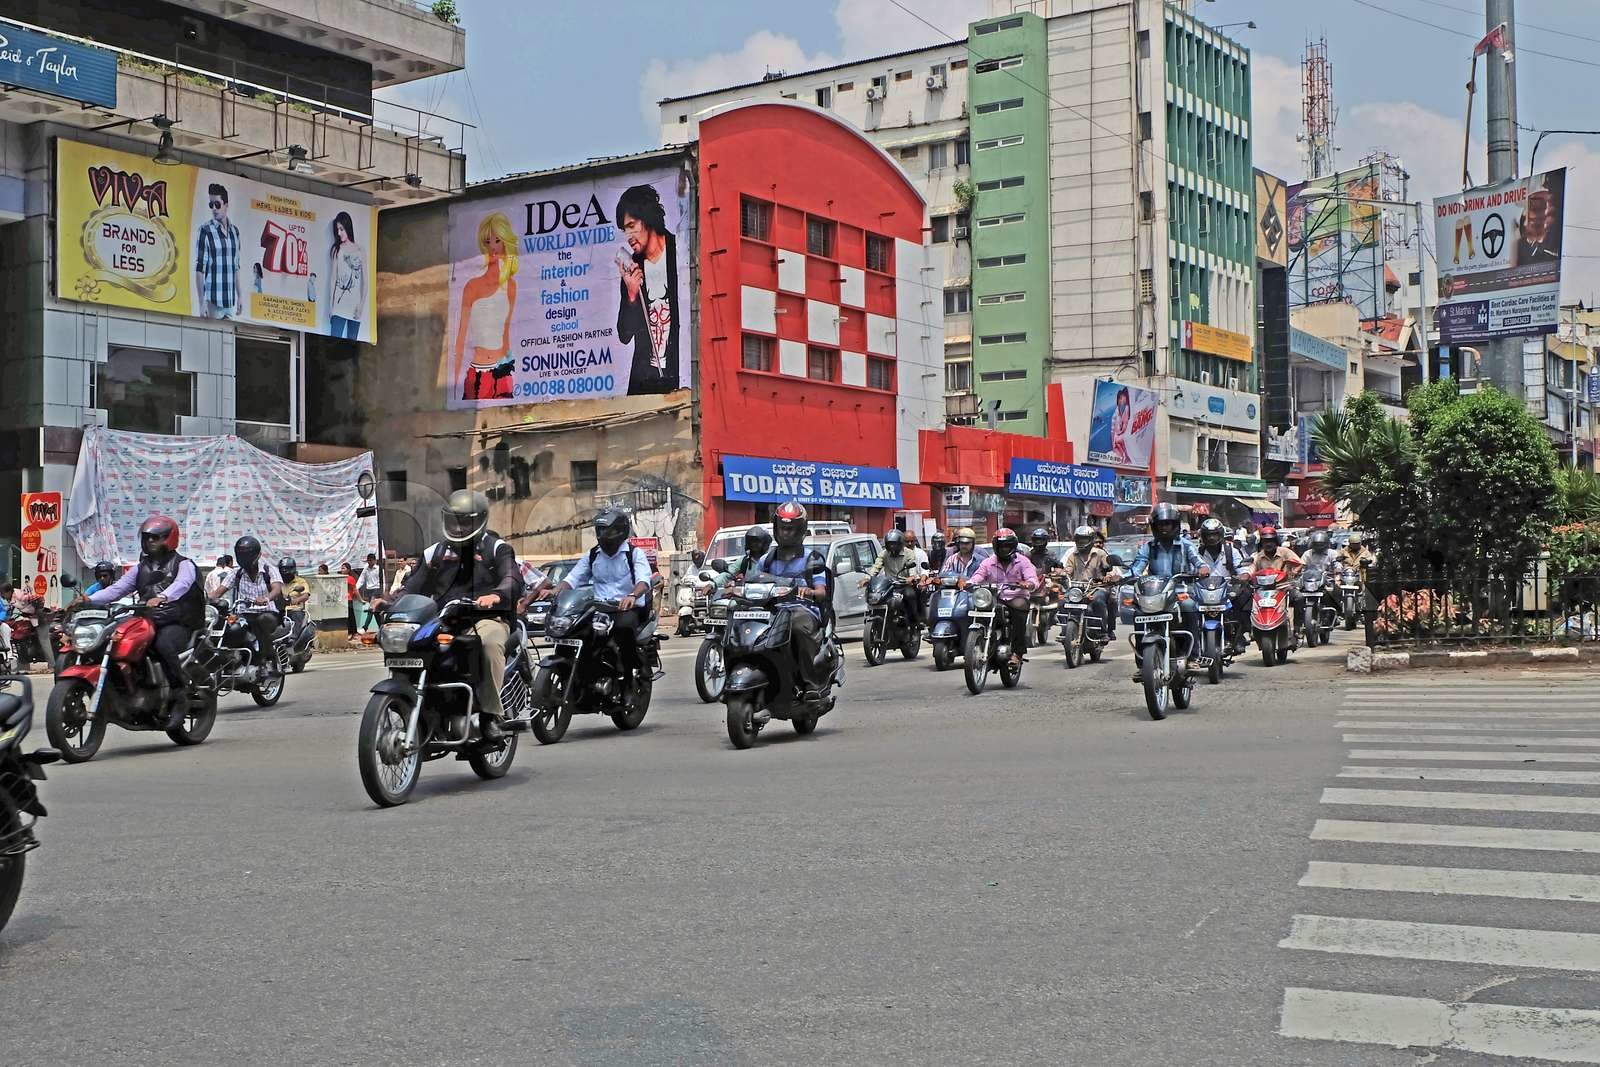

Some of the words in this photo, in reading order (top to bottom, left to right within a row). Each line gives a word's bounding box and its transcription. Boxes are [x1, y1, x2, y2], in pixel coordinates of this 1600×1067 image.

[36, 47, 78, 84] Taylor
[88, 166, 169, 219] VIVA
[1437, 205, 1447, 217] DO
[1448, 202, 1461, 215] NOT
[1486, 194, 1502, 208] AND
[1503, 187, 1527, 204] DRIVE
[524, 193, 612, 236] IDeA
[102, 222, 155, 245] BRANDS
[121, 243, 136, 254] FOR
[558, 251, 572, 260] the
[113, 254, 145, 272] LESS
[541, 261, 590, 280] interior
[560, 279, 567, 287] &
[541, 287, 589, 305] fashion
[1501, 299, 1518, 308] Cardiac
[1518, 297, 1529, 305] Care
[1529, 295, 1549, 304] Facilities
[1549, 294, 1556, 302] at
[545, 307, 577, 320] design
[1530, 304, 1541, 312] Heart
[551, 320, 578, 332] school
[520, 337, 551, 347] OFFICIAL
[552, 332, 583, 343] FASHION
[584, 328, 613, 339] PARTNER
[522, 346, 613, 372] SONUNIGAM
[561, 368, 587, 376] CONCERT
[522, 380, 565, 396] 90088
[567, 374, 614, 393] 08000
[729, 473, 814, 496] TODAYS
[820, 479, 897, 500] BAZAAR
[1013, 473, 1072, 494] AMERICAN
[1074, 480, 1115, 498] CORNER
[30, 502, 57, 521] VIVA
